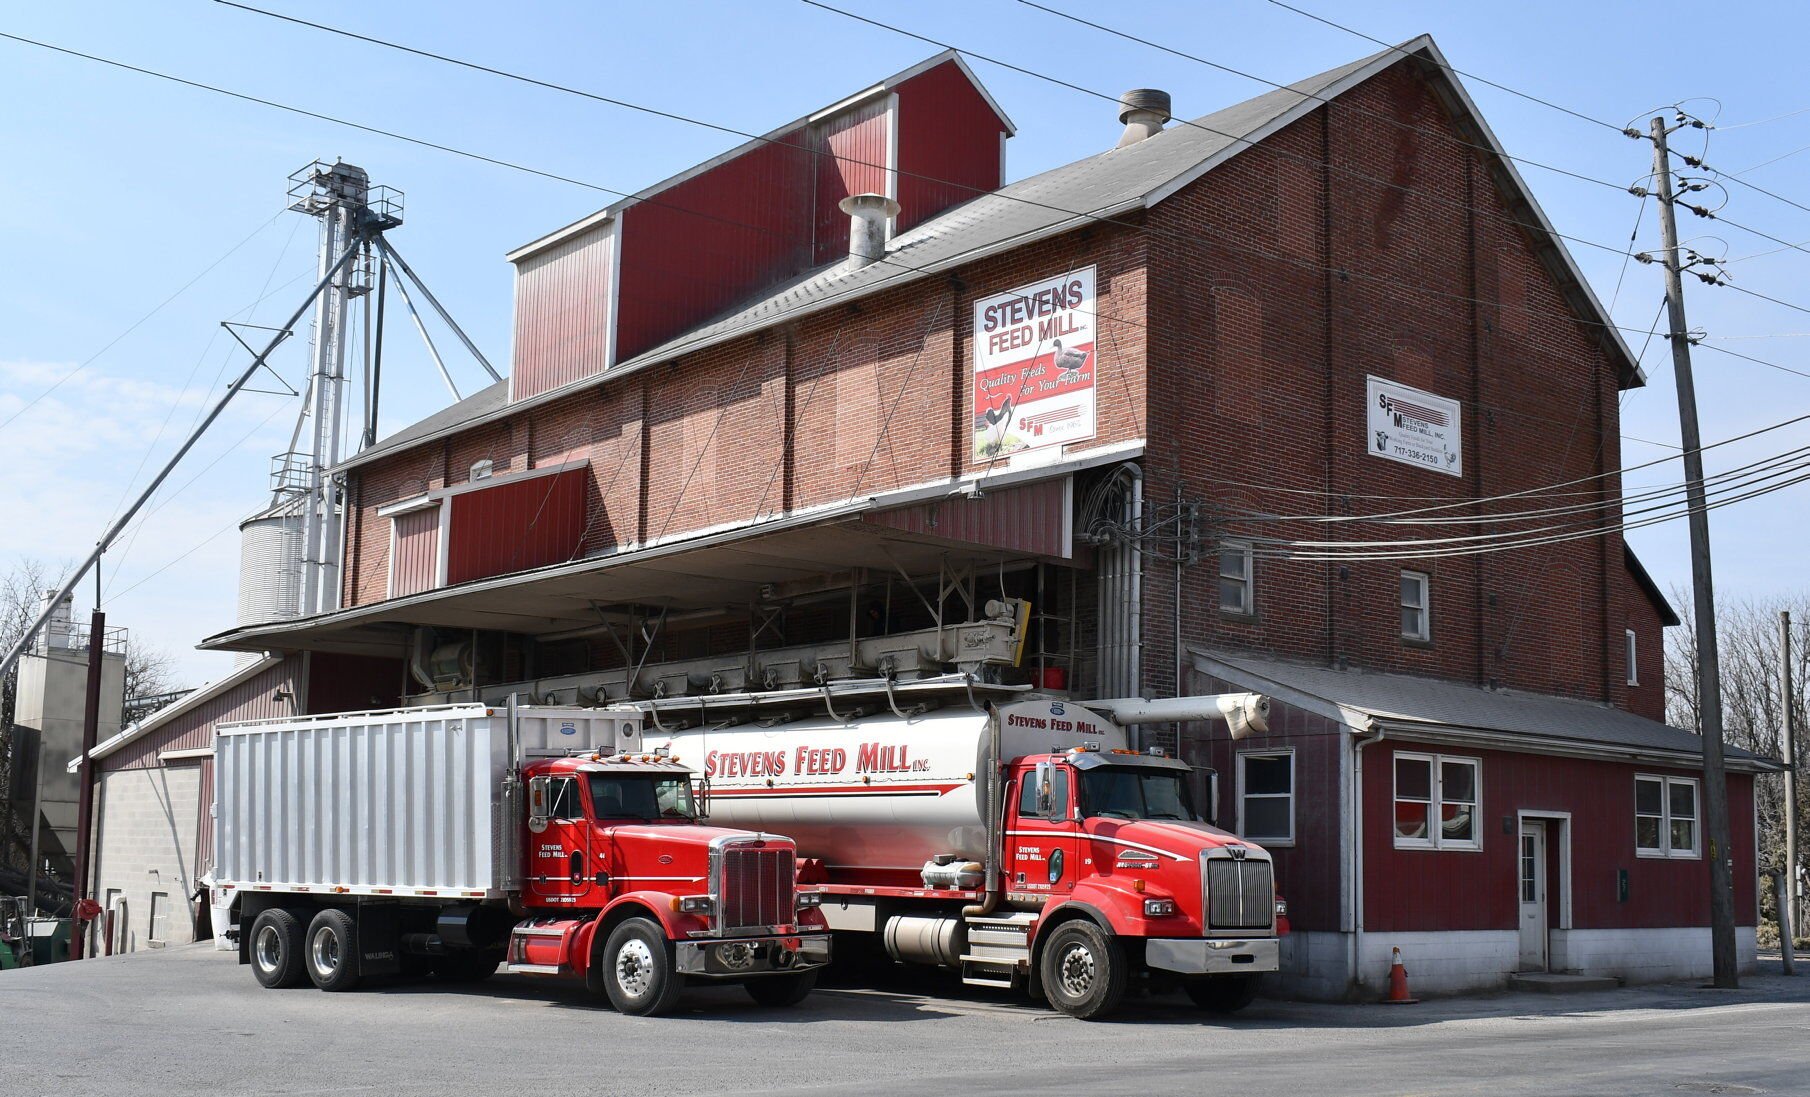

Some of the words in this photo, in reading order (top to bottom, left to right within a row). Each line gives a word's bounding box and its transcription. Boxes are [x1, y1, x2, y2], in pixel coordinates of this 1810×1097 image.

[984, 280, 1083, 333] STEVENS
[989, 323, 1033, 355] FEED
[1038, 313, 1080, 342] MILL
[979, 372, 1017, 391] Quality
[1021, 363, 1046, 380] Feeds
[1020, 384, 1035, 397] For
[1039, 379, 1059, 392] Your
[1064, 371, 1090, 386] Farm
[1379, 394, 1403, 429] SFM
[1402, 416, 1429, 429] STEVENS
[1019, 417, 1044, 437] SFM
[1402, 424, 1418, 433] FEED
[1394, 445, 1438, 464] 717-336-2150
[1008, 713, 1047, 729] STEVENS
[1050, 718, 1073, 731] FEED
[1076, 721, 1097, 734] MILL
[705, 749, 786, 778] STEVENS
[794, 745, 847, 775] FEED
[855, 742, 911, 774] MILL
[1029, 853, 1041, 861] MILL
